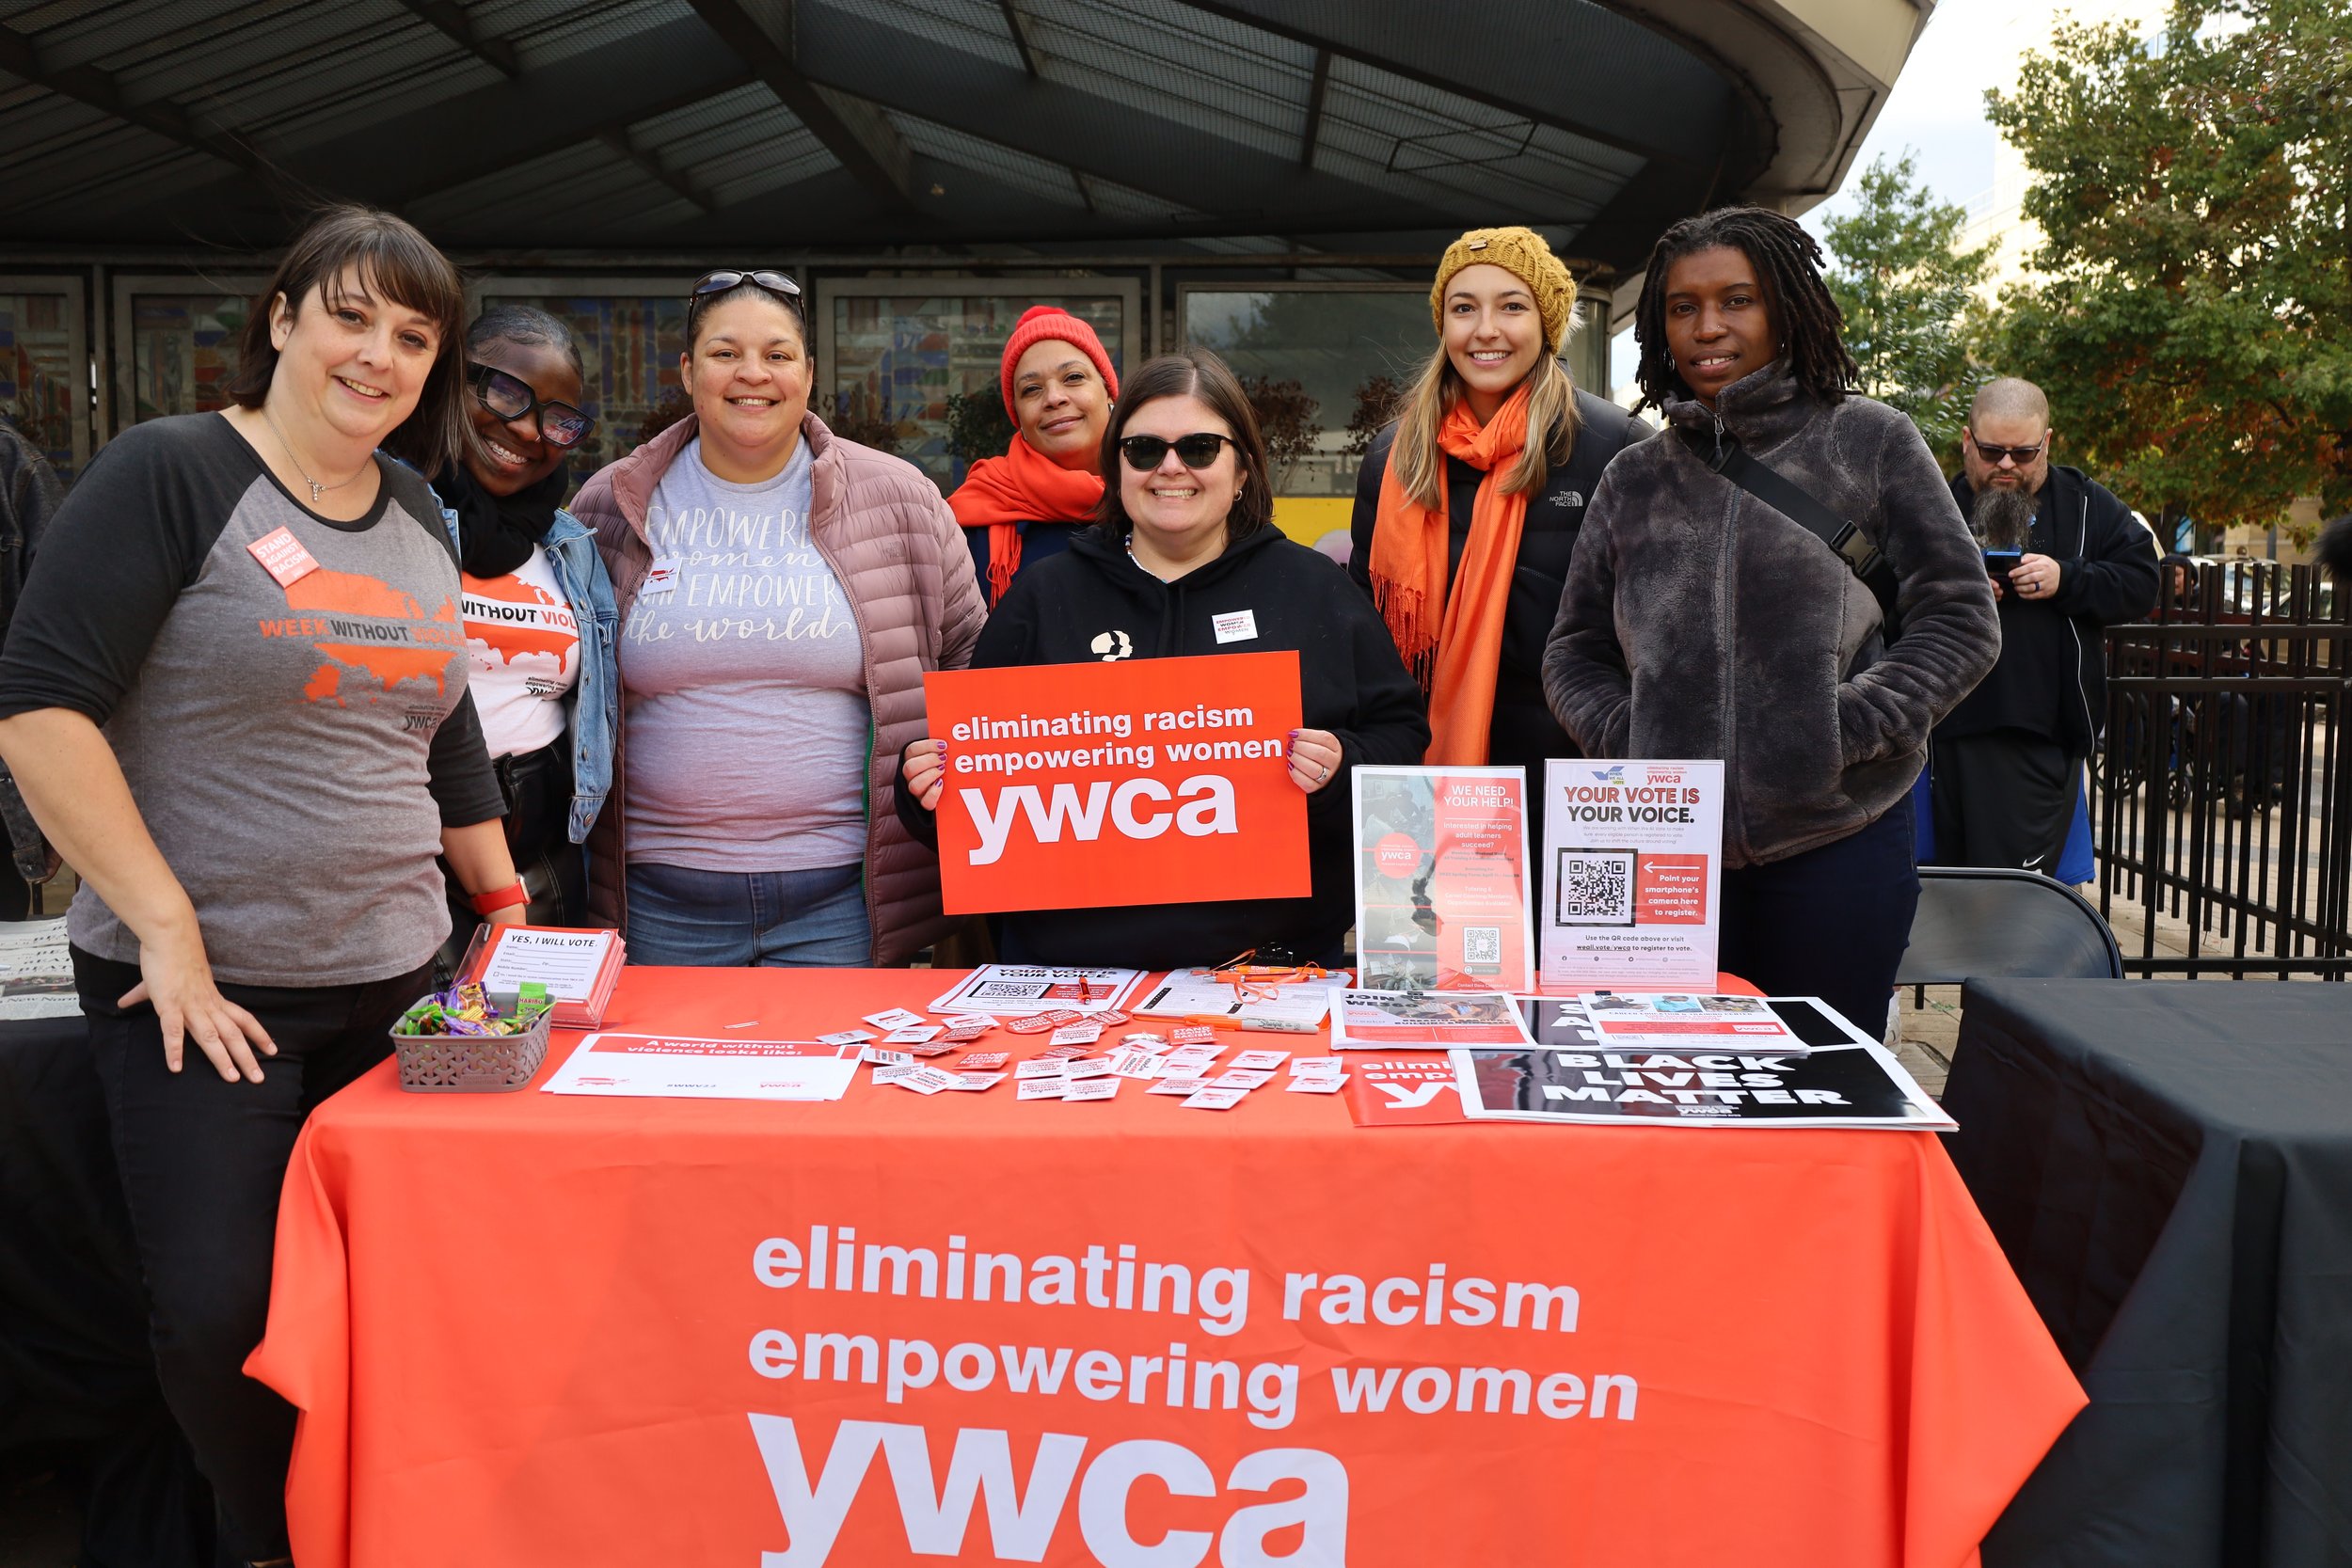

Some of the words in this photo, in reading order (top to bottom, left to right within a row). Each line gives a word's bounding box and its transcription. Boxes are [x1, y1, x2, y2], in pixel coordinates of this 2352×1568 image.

[256, 533, 291, 558] STAND
[265, 543, 298, 566] AGAINST
[273, 551, 309, 575] RACISM
[688, 574, 840, 607] EMPOWER
[259, 618, 329, 638] WEEK
[330, 620, 409, 641] WITHOUT
[540, 610, 577, 629] VIOL
[622, 610, 675, 646] the
[684, 607, 851, 642] world
[403, 715, 437, 731] ywca
[951, 710, 1132, 741] eliminating
[1143, 705, 1253, 731] racism
[954, 741, 1154, 776] empowering
[1165, 737, 1283, 763] women
[1646, 775, 1681, 785] ywca
[1452, 785, 1471, 795] WE
[1475, 786, 1505, 796] NEED
[1564, 786, 1619, 802] YOUR
[1625, 787, 1677, 804] VOTE
[1682, 788, 1700, 804] IS
[1443, 797, 1478, 807] YOUR
[1482, 798, 1514, 808] HELP!
[959, 774, 1239, 865] ywca
[1567, 806, 1623, 822] YOUR
[1628, 806, 1694, 823] VOICE.
[1381, 851, 1411, 862] ywca
[512, 935, 532, 944] YES,
[542, 938, 565, 946] WILL
[1258, 1020, 1285, 1028] Sharpie
[1556, 1054, 1796, 1070] BLACK
[1581, 1071, 1785, 1087] LIVES
[1541, 1085, 1852, 1105] MATTER
[754, 1225, 1250, 1337] eliminating
[1282, 1262, 1581, 1334] racism
[748, 1327, 1300, 1431] empowering
[1330, 1355, 1639, 1421] women
[747, 1411, 1350, 1568] ywca
